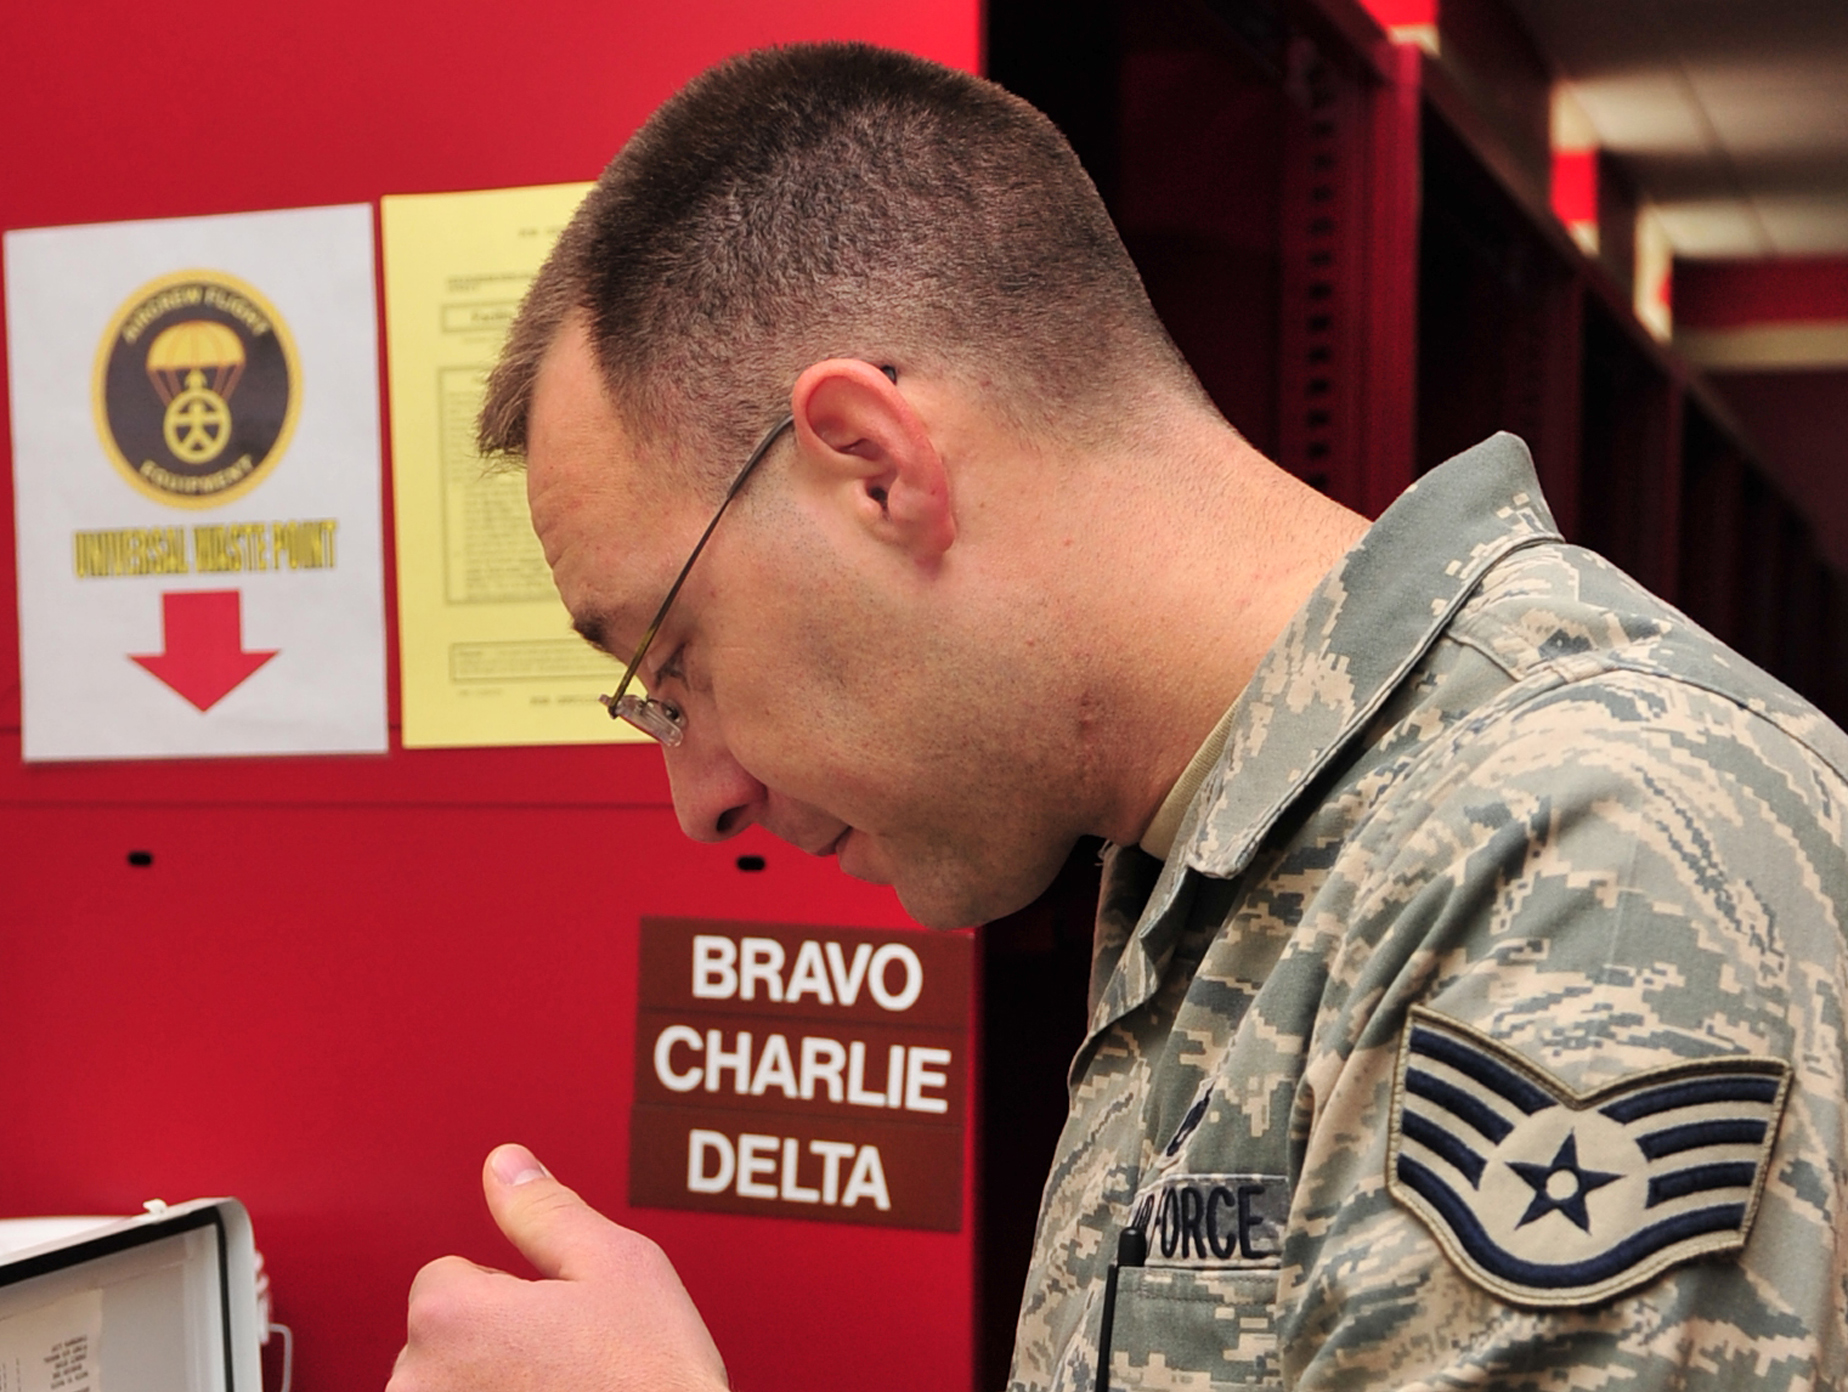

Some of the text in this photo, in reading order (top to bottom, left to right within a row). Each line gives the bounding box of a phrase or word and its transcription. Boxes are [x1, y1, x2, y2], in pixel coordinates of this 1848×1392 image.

[73, 517, 338, 579] UNIVERSAL WASTE POINT
[692, 935, 924, 1011] BRAVO
[653, 1025, 952, 1114] CHARLIE
[687, 1129, 892, 1211] DELTA
[1149, 1184, 1270, 1260] FORCE
